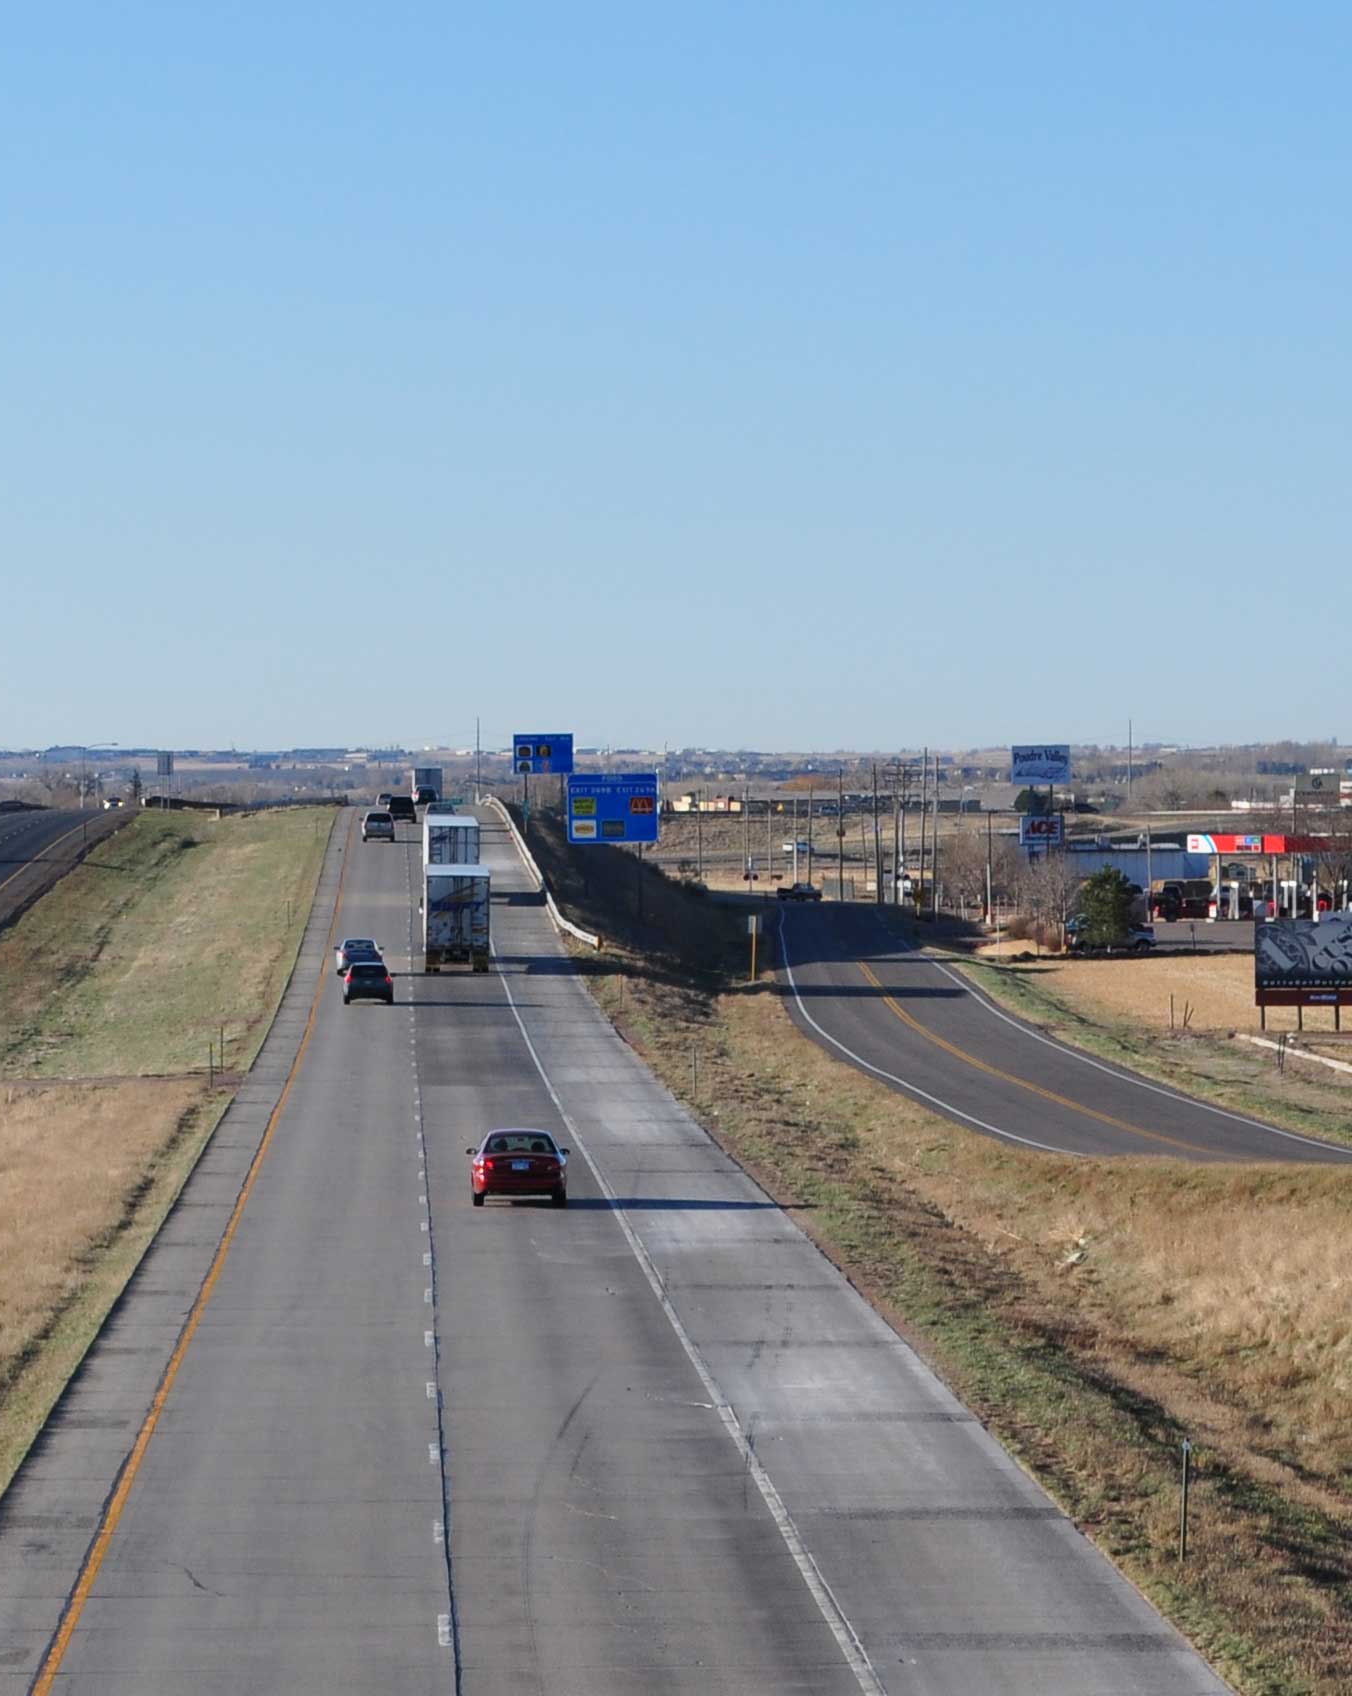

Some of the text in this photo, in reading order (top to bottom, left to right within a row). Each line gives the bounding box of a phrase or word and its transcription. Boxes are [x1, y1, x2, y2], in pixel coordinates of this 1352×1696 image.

[1014, 749, 1068, 766] Poudre Valley
[1025, 819, 1059, 834] ACE
